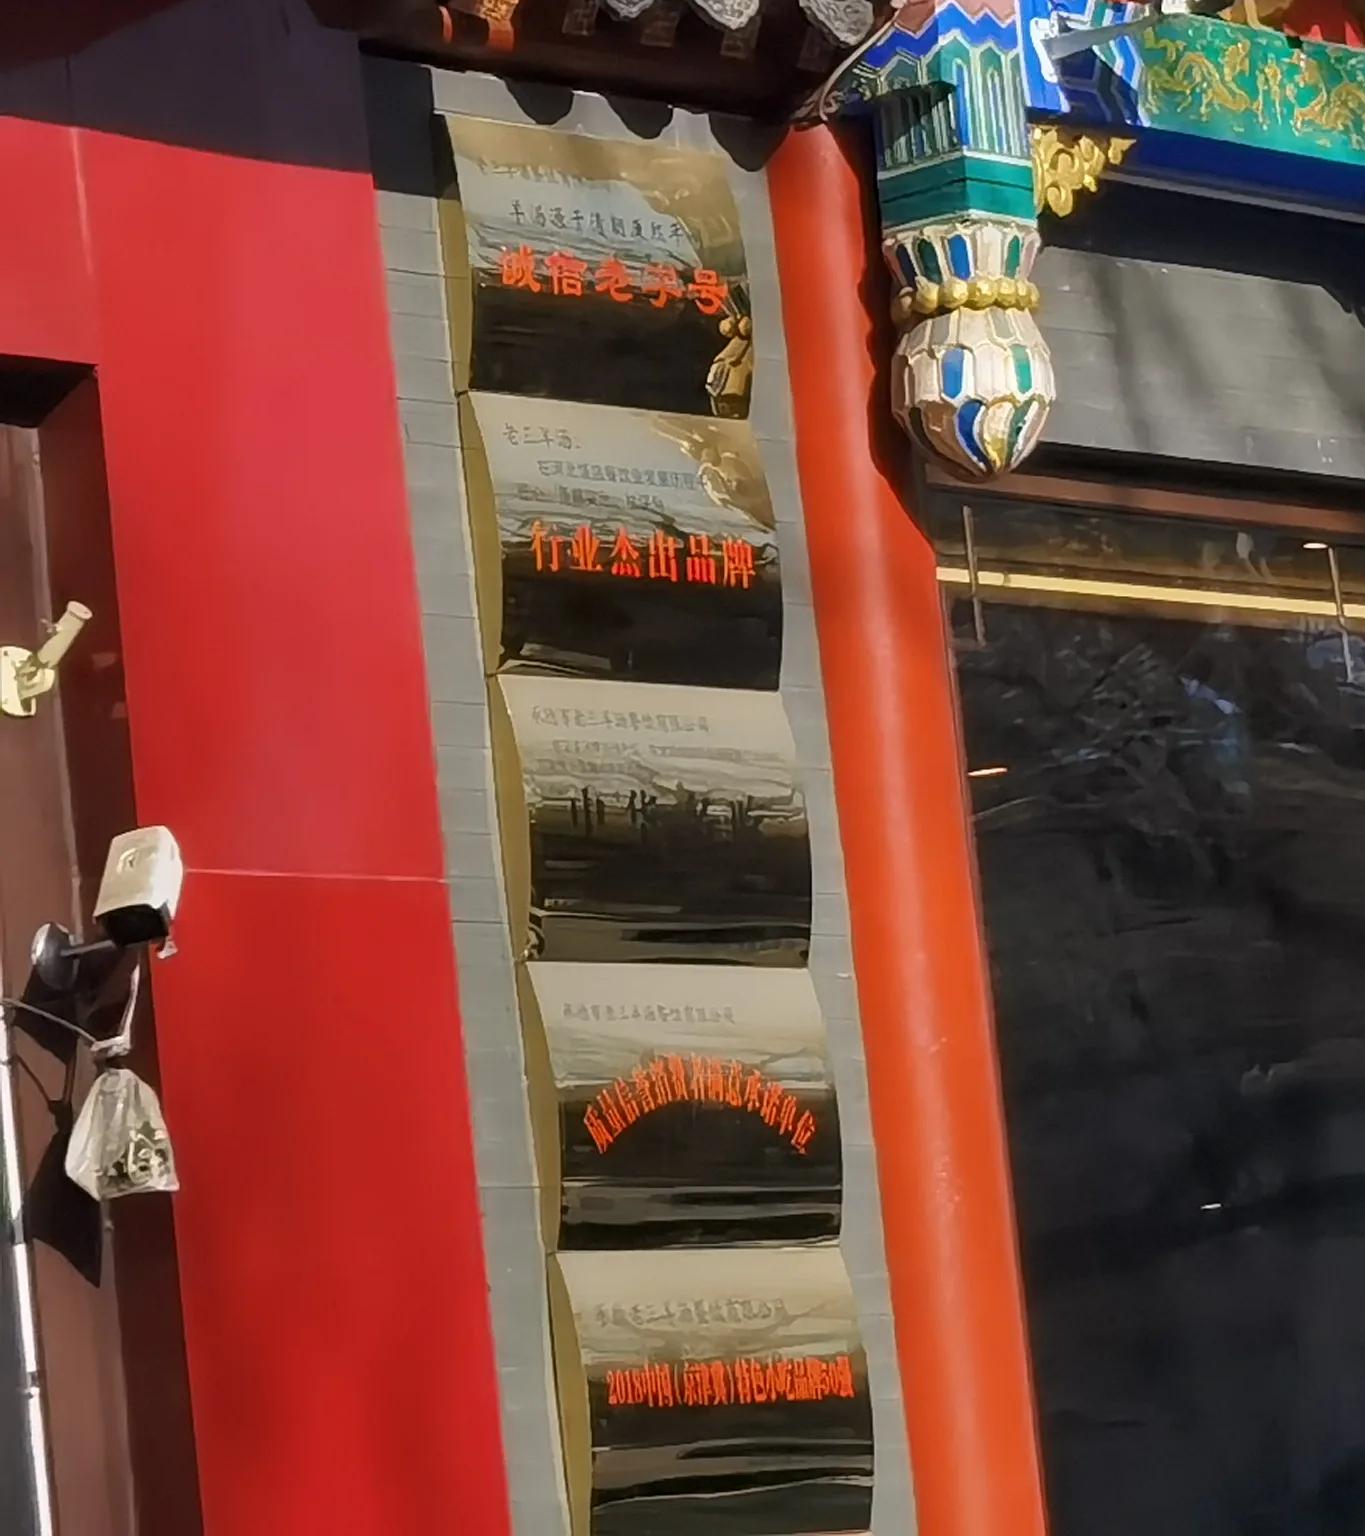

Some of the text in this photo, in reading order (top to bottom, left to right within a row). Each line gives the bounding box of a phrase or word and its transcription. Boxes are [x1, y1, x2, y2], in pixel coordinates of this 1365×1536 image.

[499, 243, 728, 316] 诚信老字号
[531, 519, 757, 589] 行业杰出品牌
